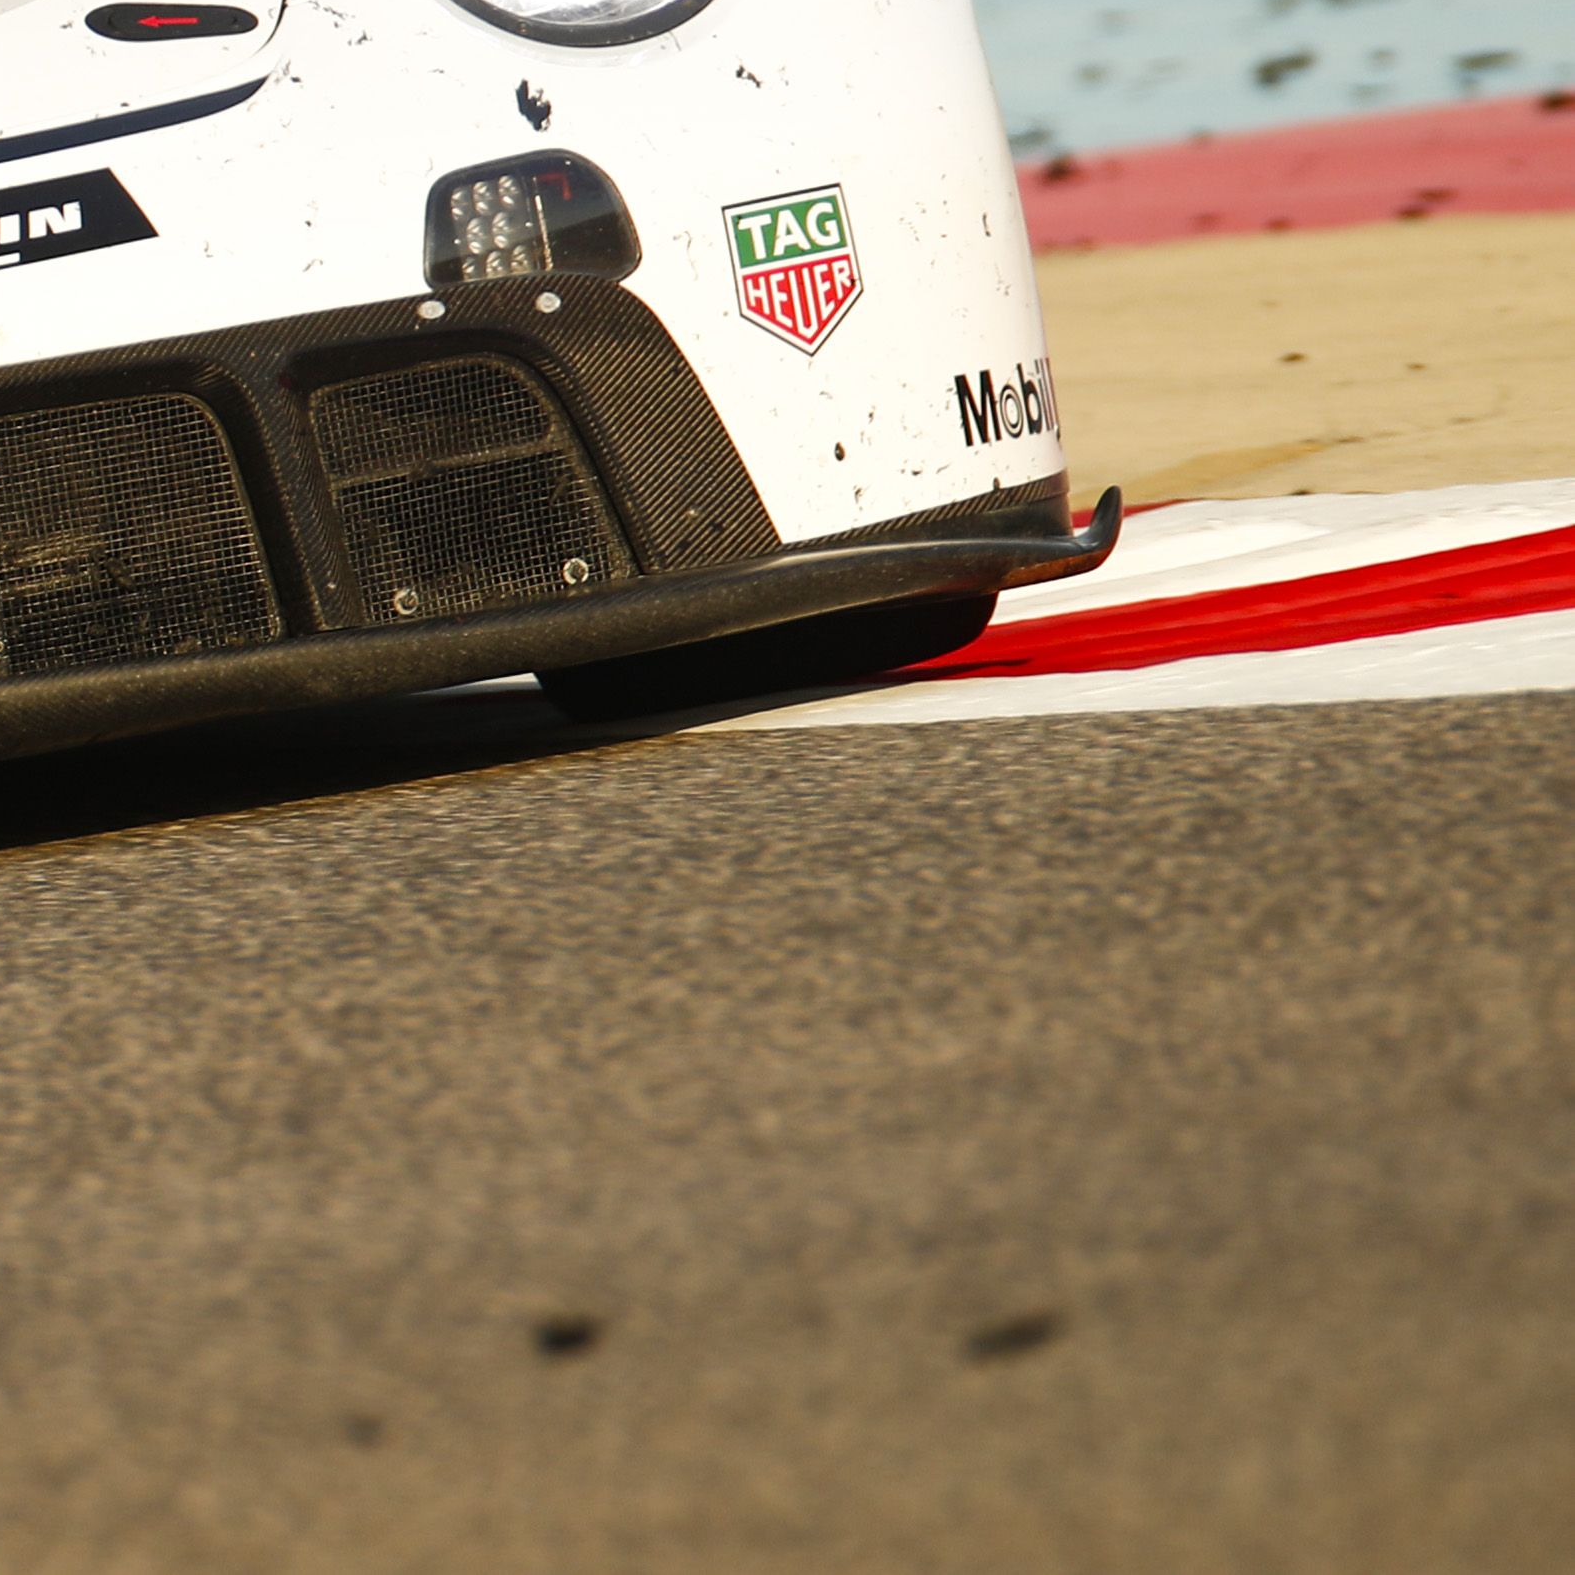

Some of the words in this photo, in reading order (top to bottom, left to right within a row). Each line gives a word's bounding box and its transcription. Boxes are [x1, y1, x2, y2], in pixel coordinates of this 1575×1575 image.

[737, 201, 841, 261] TAG
[745, 258, 852, 340] HEUER
[954, 358, 1054, 447] Mobil
